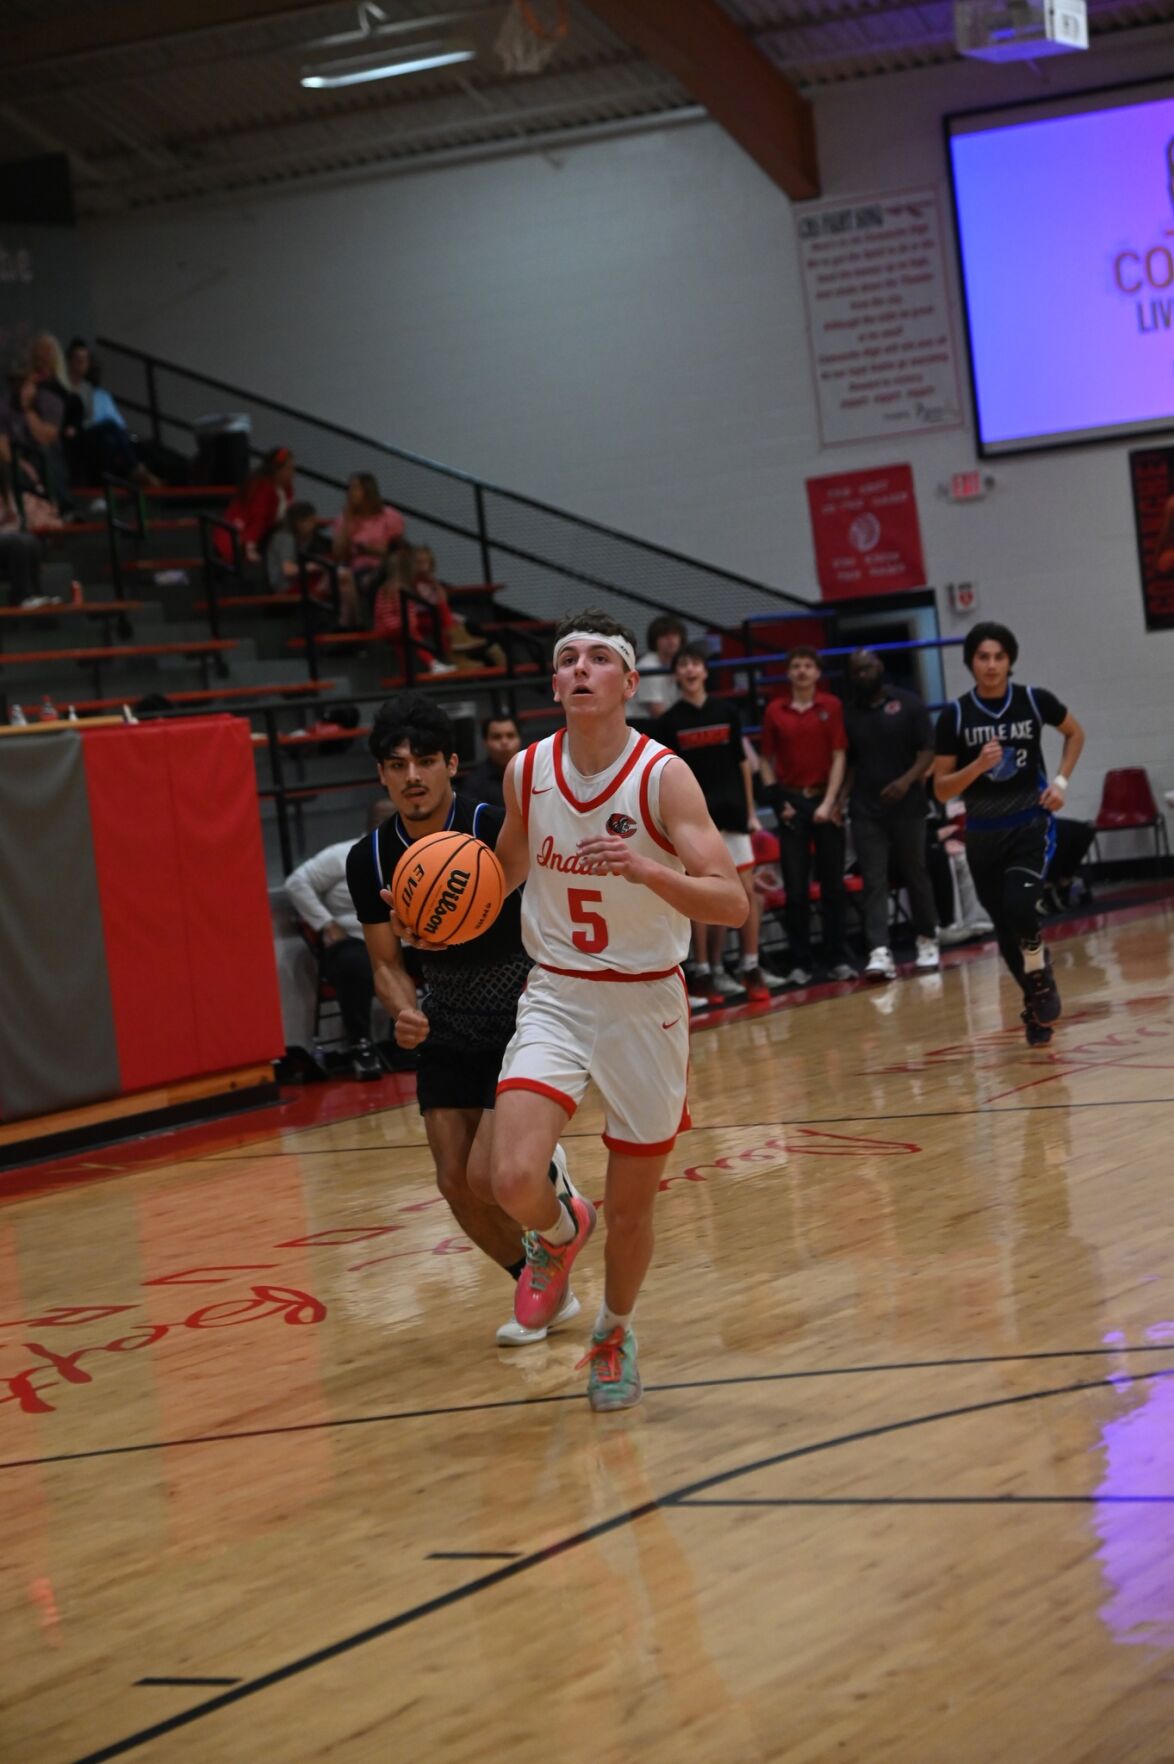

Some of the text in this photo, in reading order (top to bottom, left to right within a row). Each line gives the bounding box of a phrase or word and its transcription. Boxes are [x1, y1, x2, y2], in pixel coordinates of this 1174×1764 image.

[1010, 719, 1034, 740] AXE
[1015, 748, 1028, 768] 2
[423, 869, 471, 934] Wilson
[567, 887, 609, 954] 5
